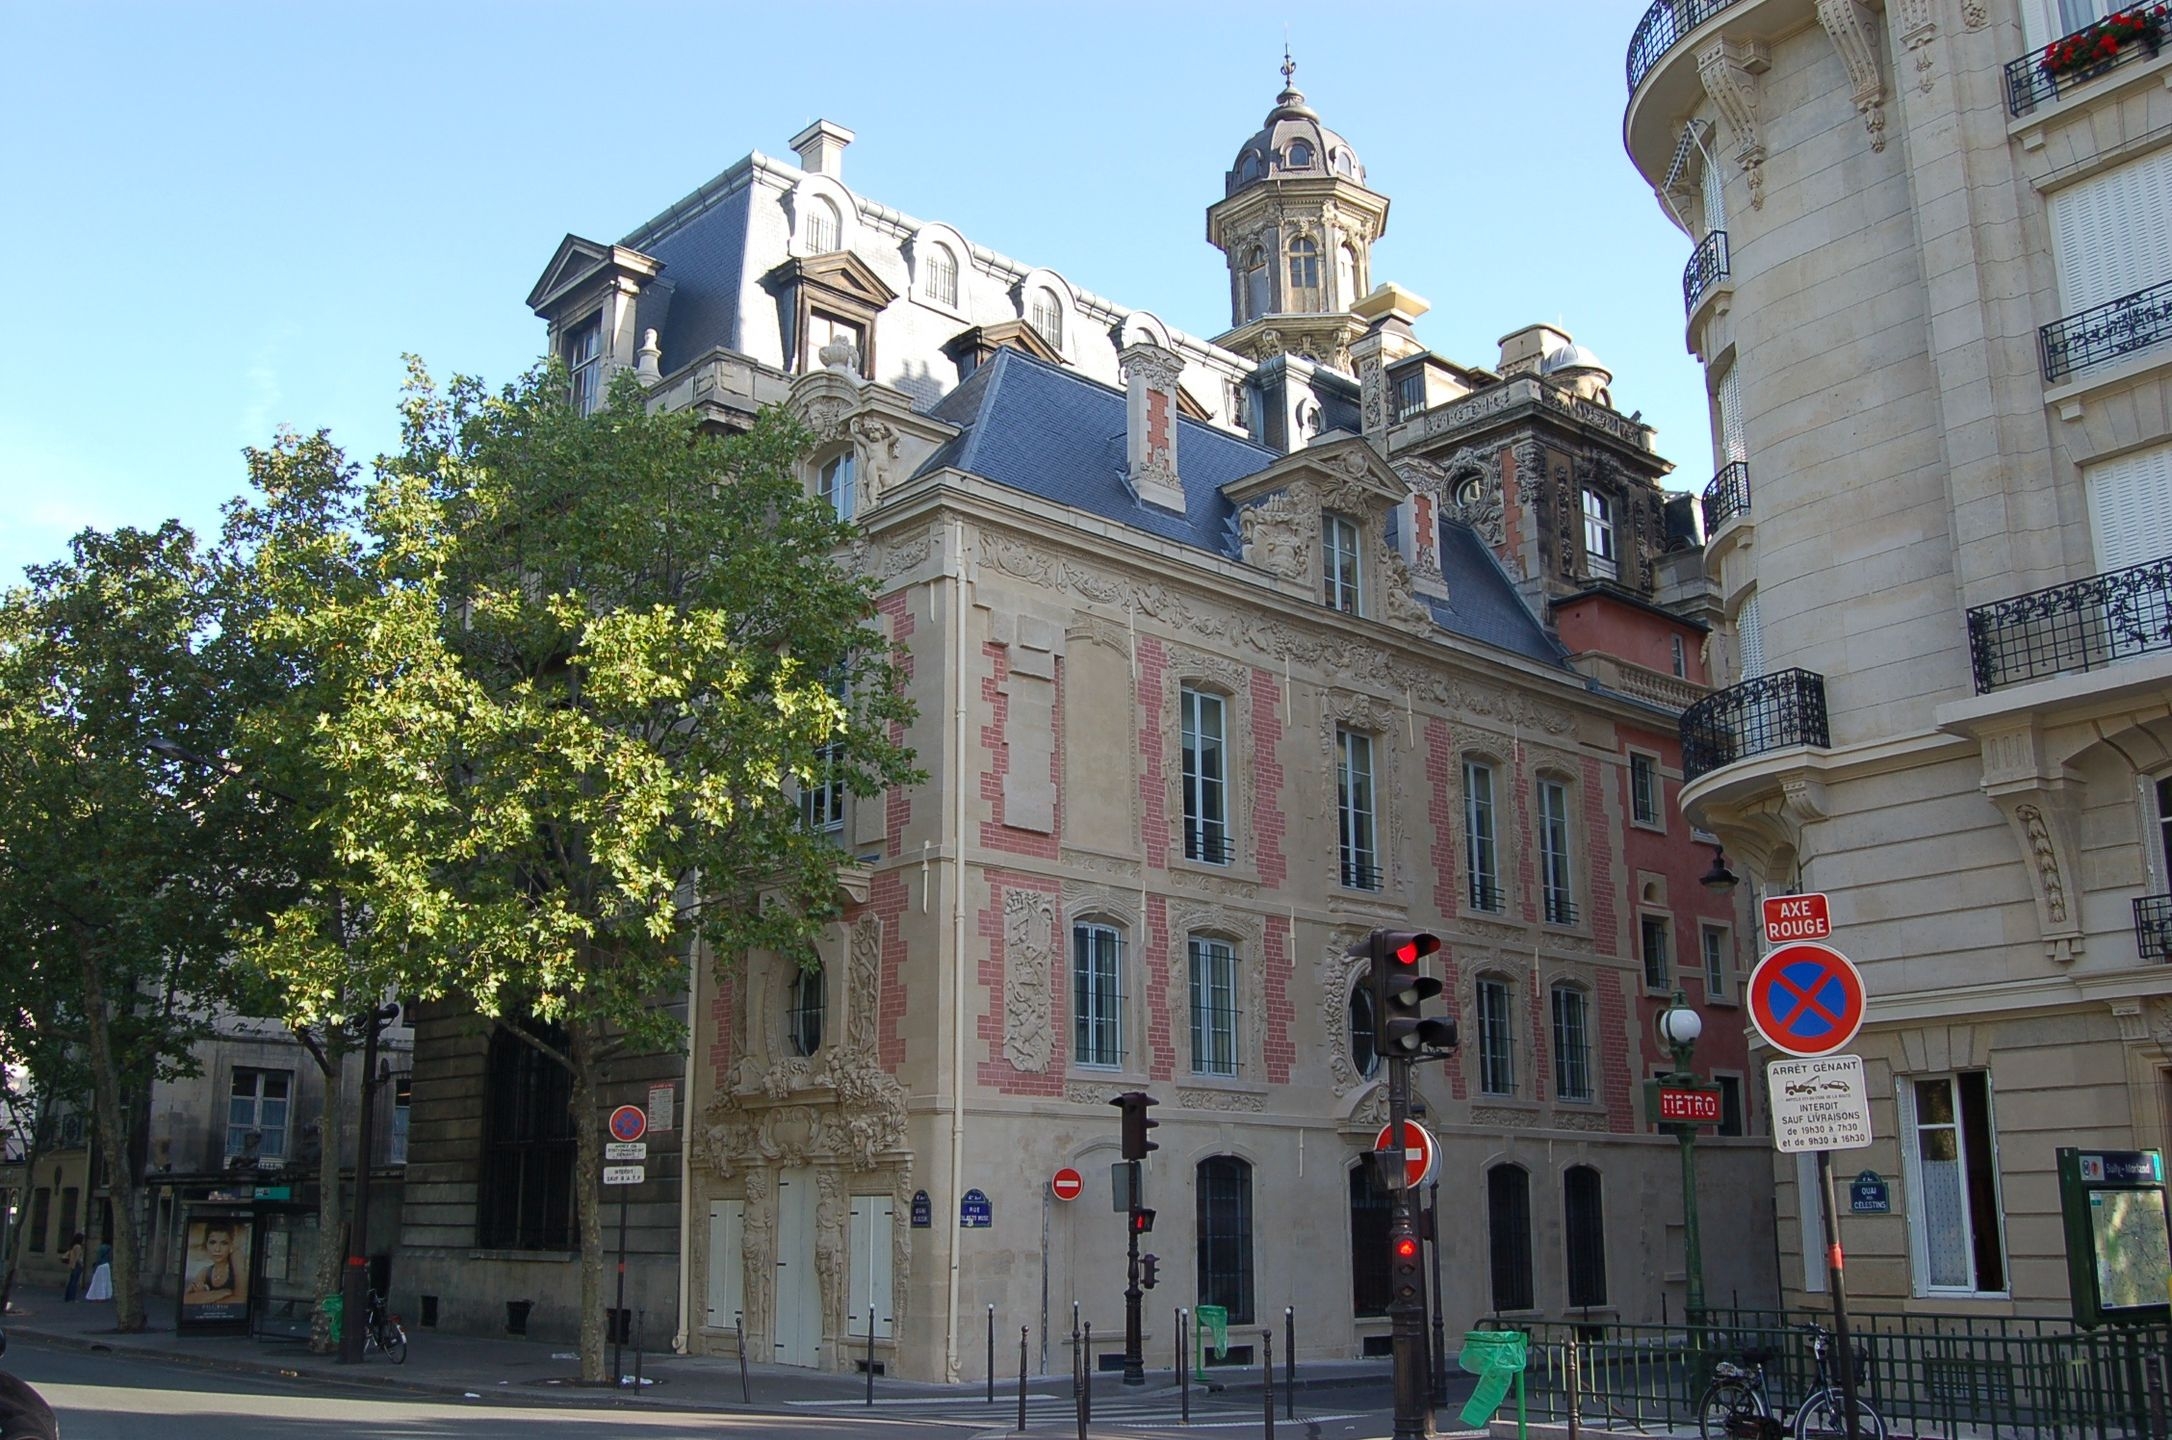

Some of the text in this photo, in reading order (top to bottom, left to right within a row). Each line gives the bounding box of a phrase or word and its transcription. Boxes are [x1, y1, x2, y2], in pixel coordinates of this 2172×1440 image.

[1780, 900, 1812, 918] AXE
[1768, 917, 1826, 937] ROUGE
[1772, 1061, 1857, 1075] ARRÊT GÊNANT
[1800, 1101, 1838, 1112] INTERDIT
[1782, 1111, 1860, 1125] SAUF LIVRAISONS
[1787, 1127, 1797, 1136] de
[1801, 1125, 1825, 1135] 19h30
[1837, 1123, 1858, 1132] 7h30
[1782, 1139, 1791, 1147] et
[1794, 1137, 1804, 1146] de
[1808, 1136, 1829, 1145] 9h30
[1841, 1133, 1865, 1143] 16h30
[1861, 1187, 1877, 1195] QUAI
